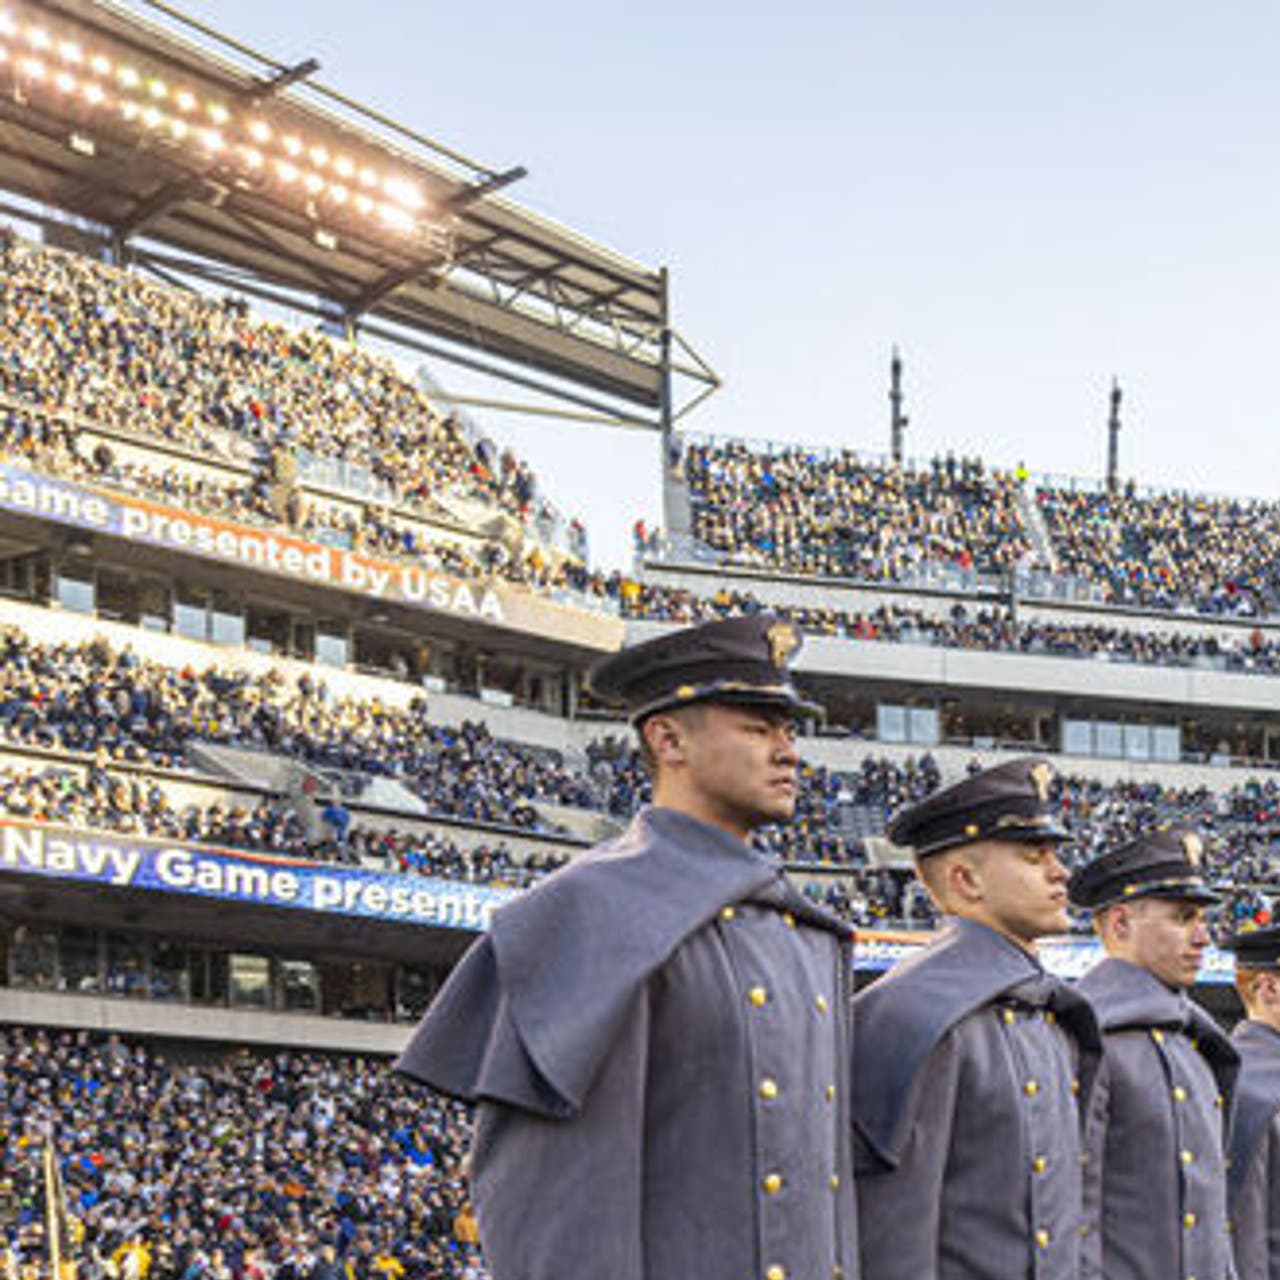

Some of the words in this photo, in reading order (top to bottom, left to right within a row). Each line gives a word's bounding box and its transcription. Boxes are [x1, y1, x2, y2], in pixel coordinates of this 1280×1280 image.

[122, 506, 331, 583] presented
[342, 551, 391, 598] by
[402, 568, 504, 624] USAA
[3, 827, 139, 886] Navy
[157, 849, 299, 902] Game
